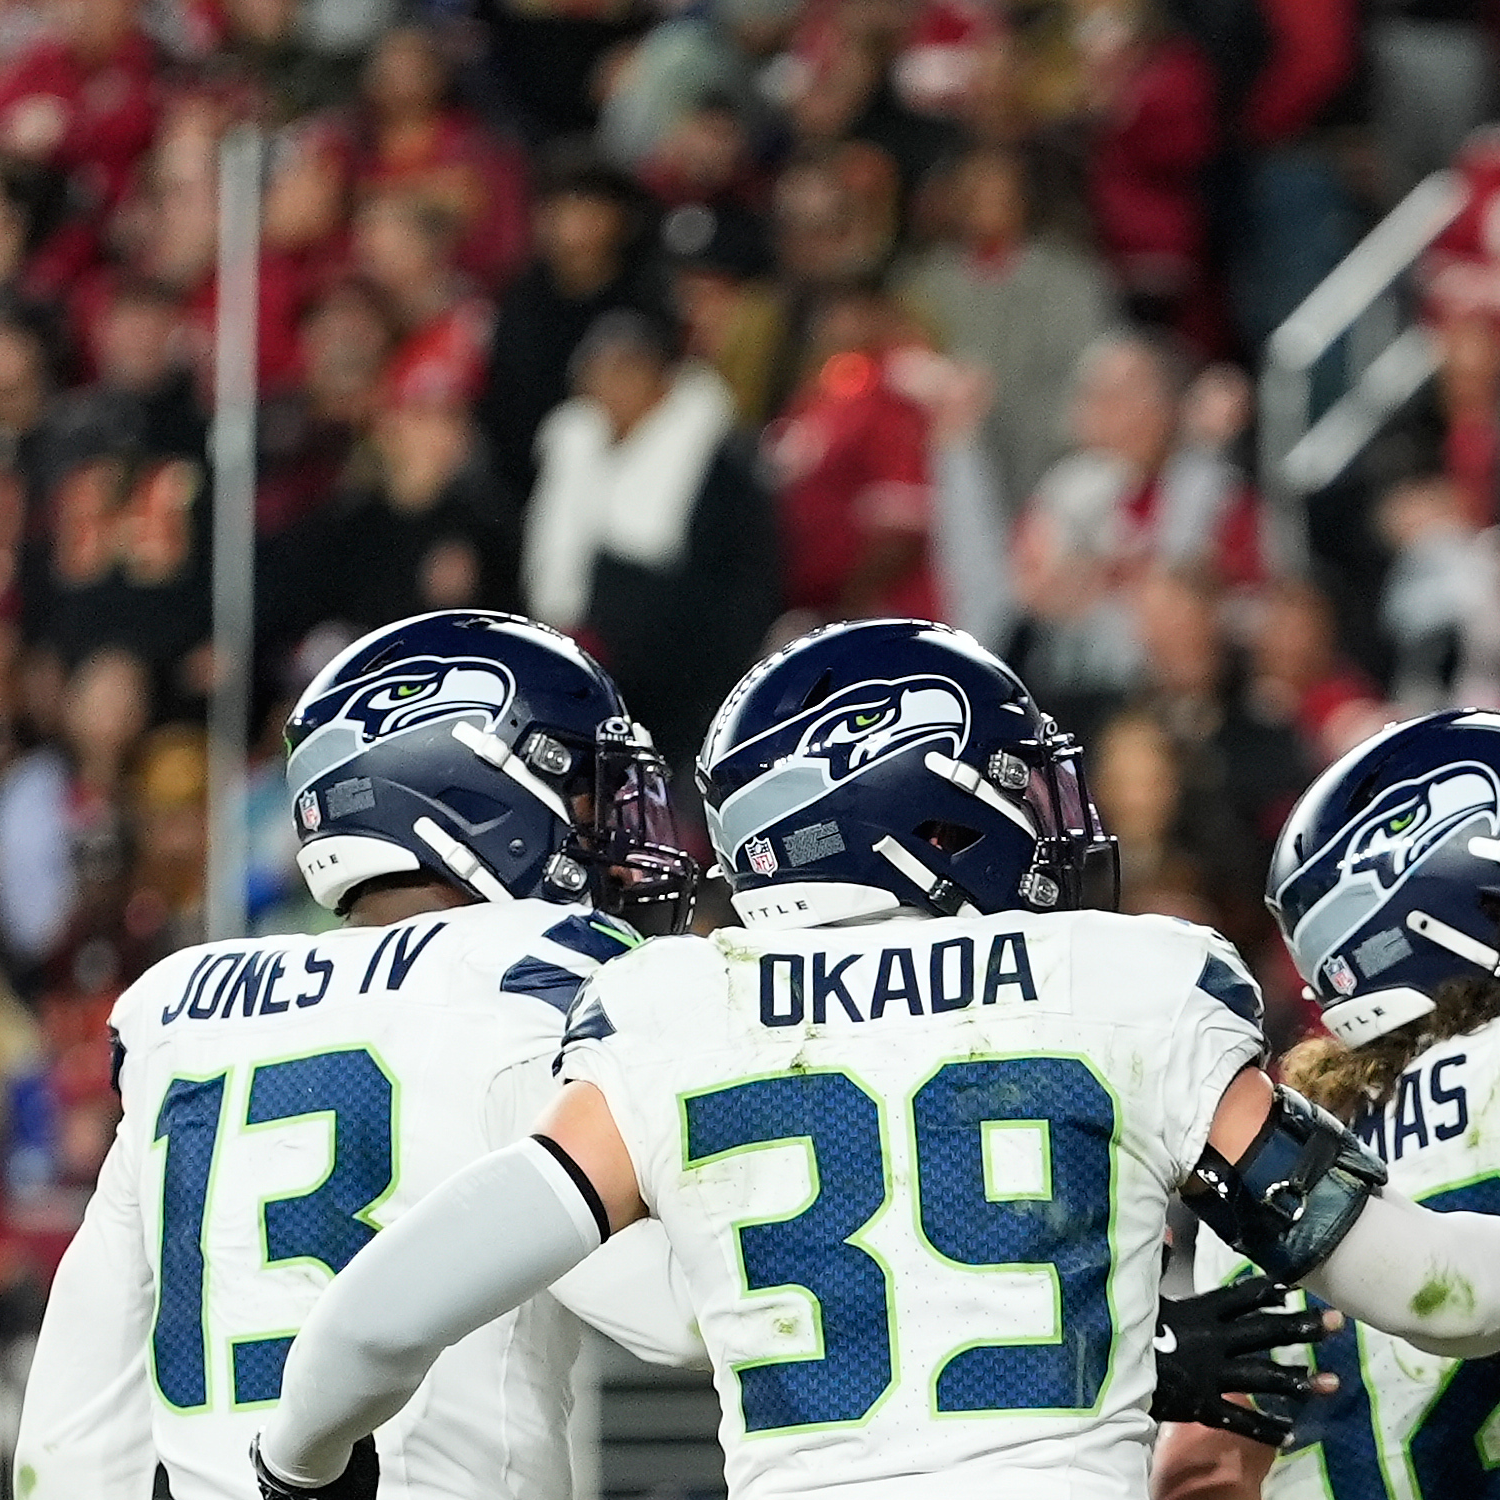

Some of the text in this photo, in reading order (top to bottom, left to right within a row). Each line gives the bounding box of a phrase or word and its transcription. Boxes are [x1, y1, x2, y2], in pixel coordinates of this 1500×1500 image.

[752, 853, 775, 872] NFL
[161, 921, 450, 1027] JONES IV
[759, 931, 1039, 1028] OKADA
[149, 1042, 402, 1417] 13
[675, 1050, 1124, 1441] 39
